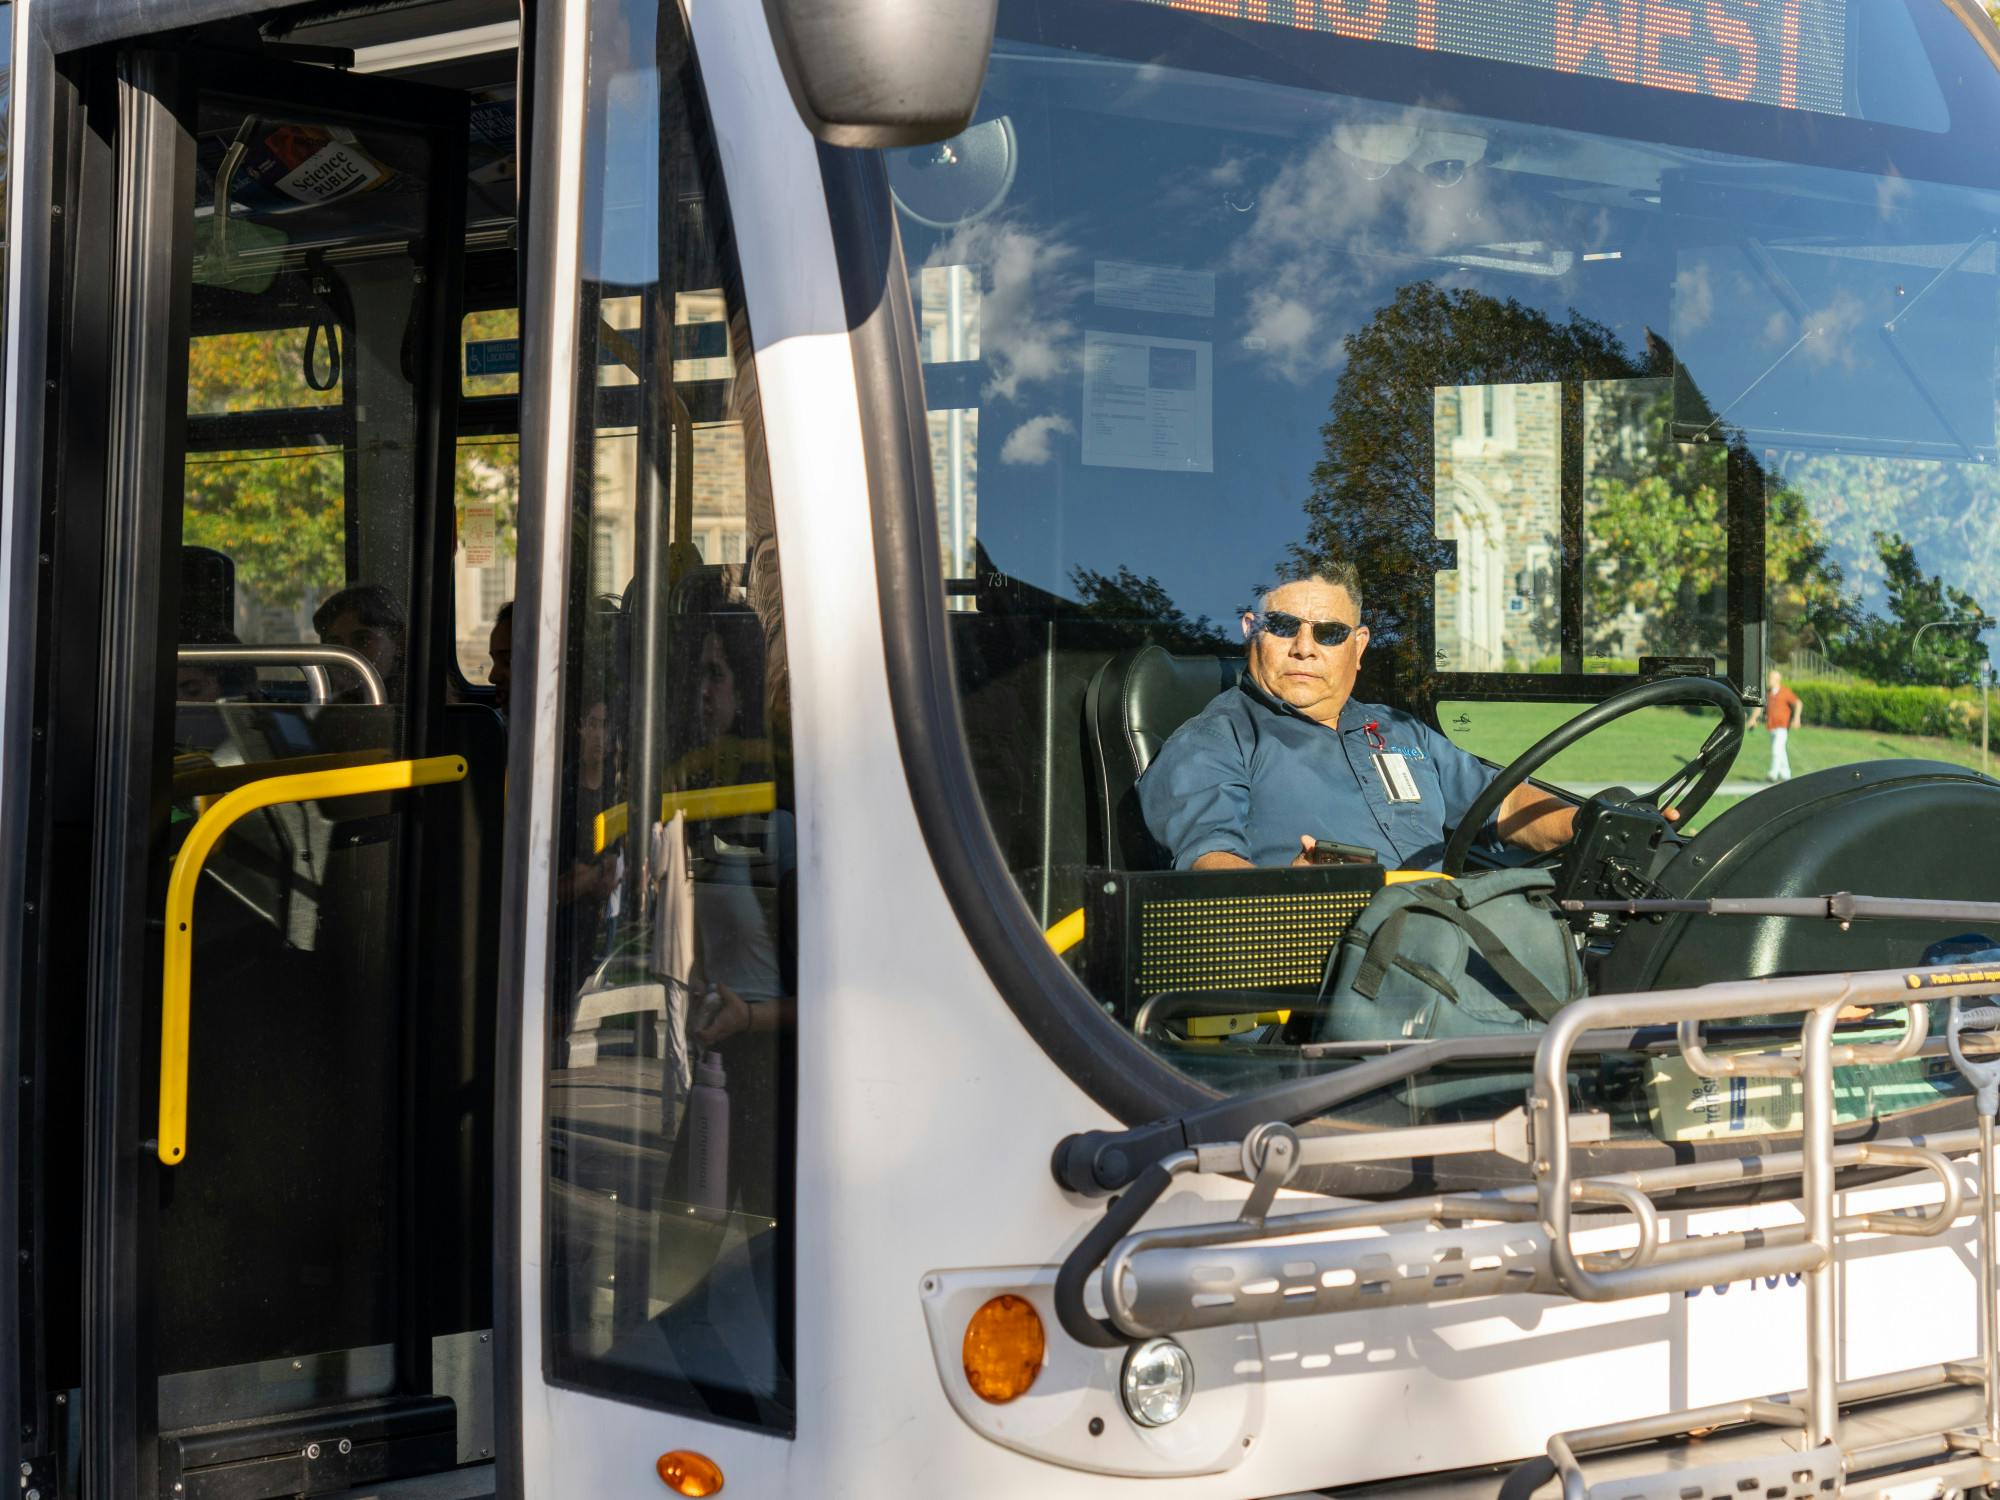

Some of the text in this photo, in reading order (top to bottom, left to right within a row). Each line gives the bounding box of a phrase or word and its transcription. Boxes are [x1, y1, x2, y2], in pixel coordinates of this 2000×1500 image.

[292, 151, 348, 191] Science
[313, 162, 360, 195] PUBLIC
[987, 572, 1009, 588] 731
